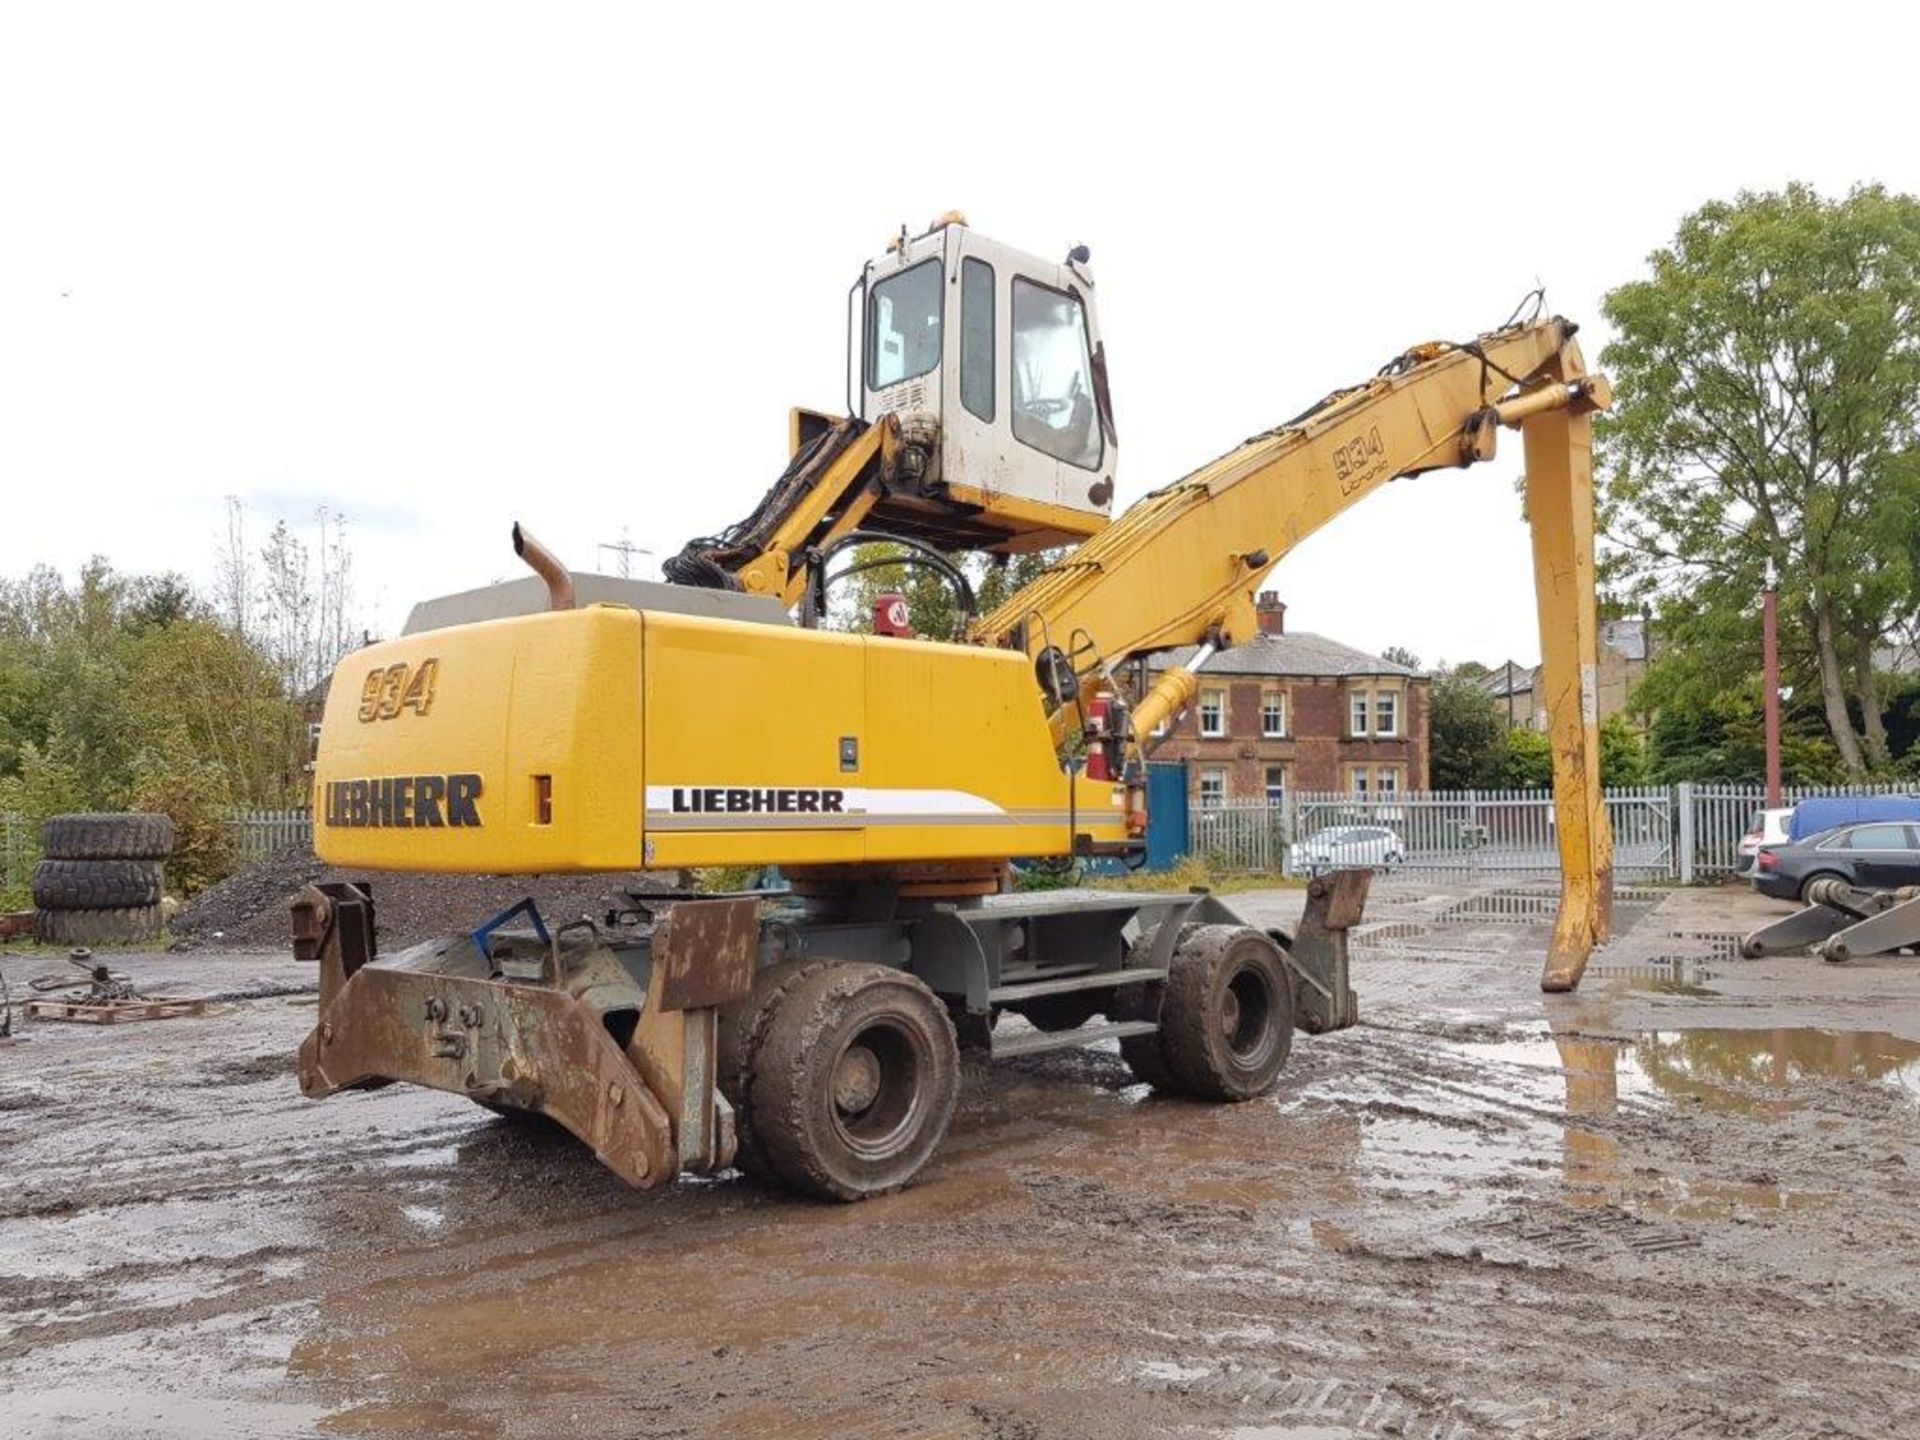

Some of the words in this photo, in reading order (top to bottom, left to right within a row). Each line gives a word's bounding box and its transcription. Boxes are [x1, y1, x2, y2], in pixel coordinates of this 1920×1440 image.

[1333, 426, 1384, 480] 934
[358, 657, 438, 723] 934
[326, 774, 483, 827] LIEBHERR
[672, 789, 844, 813] LIEBHERR
